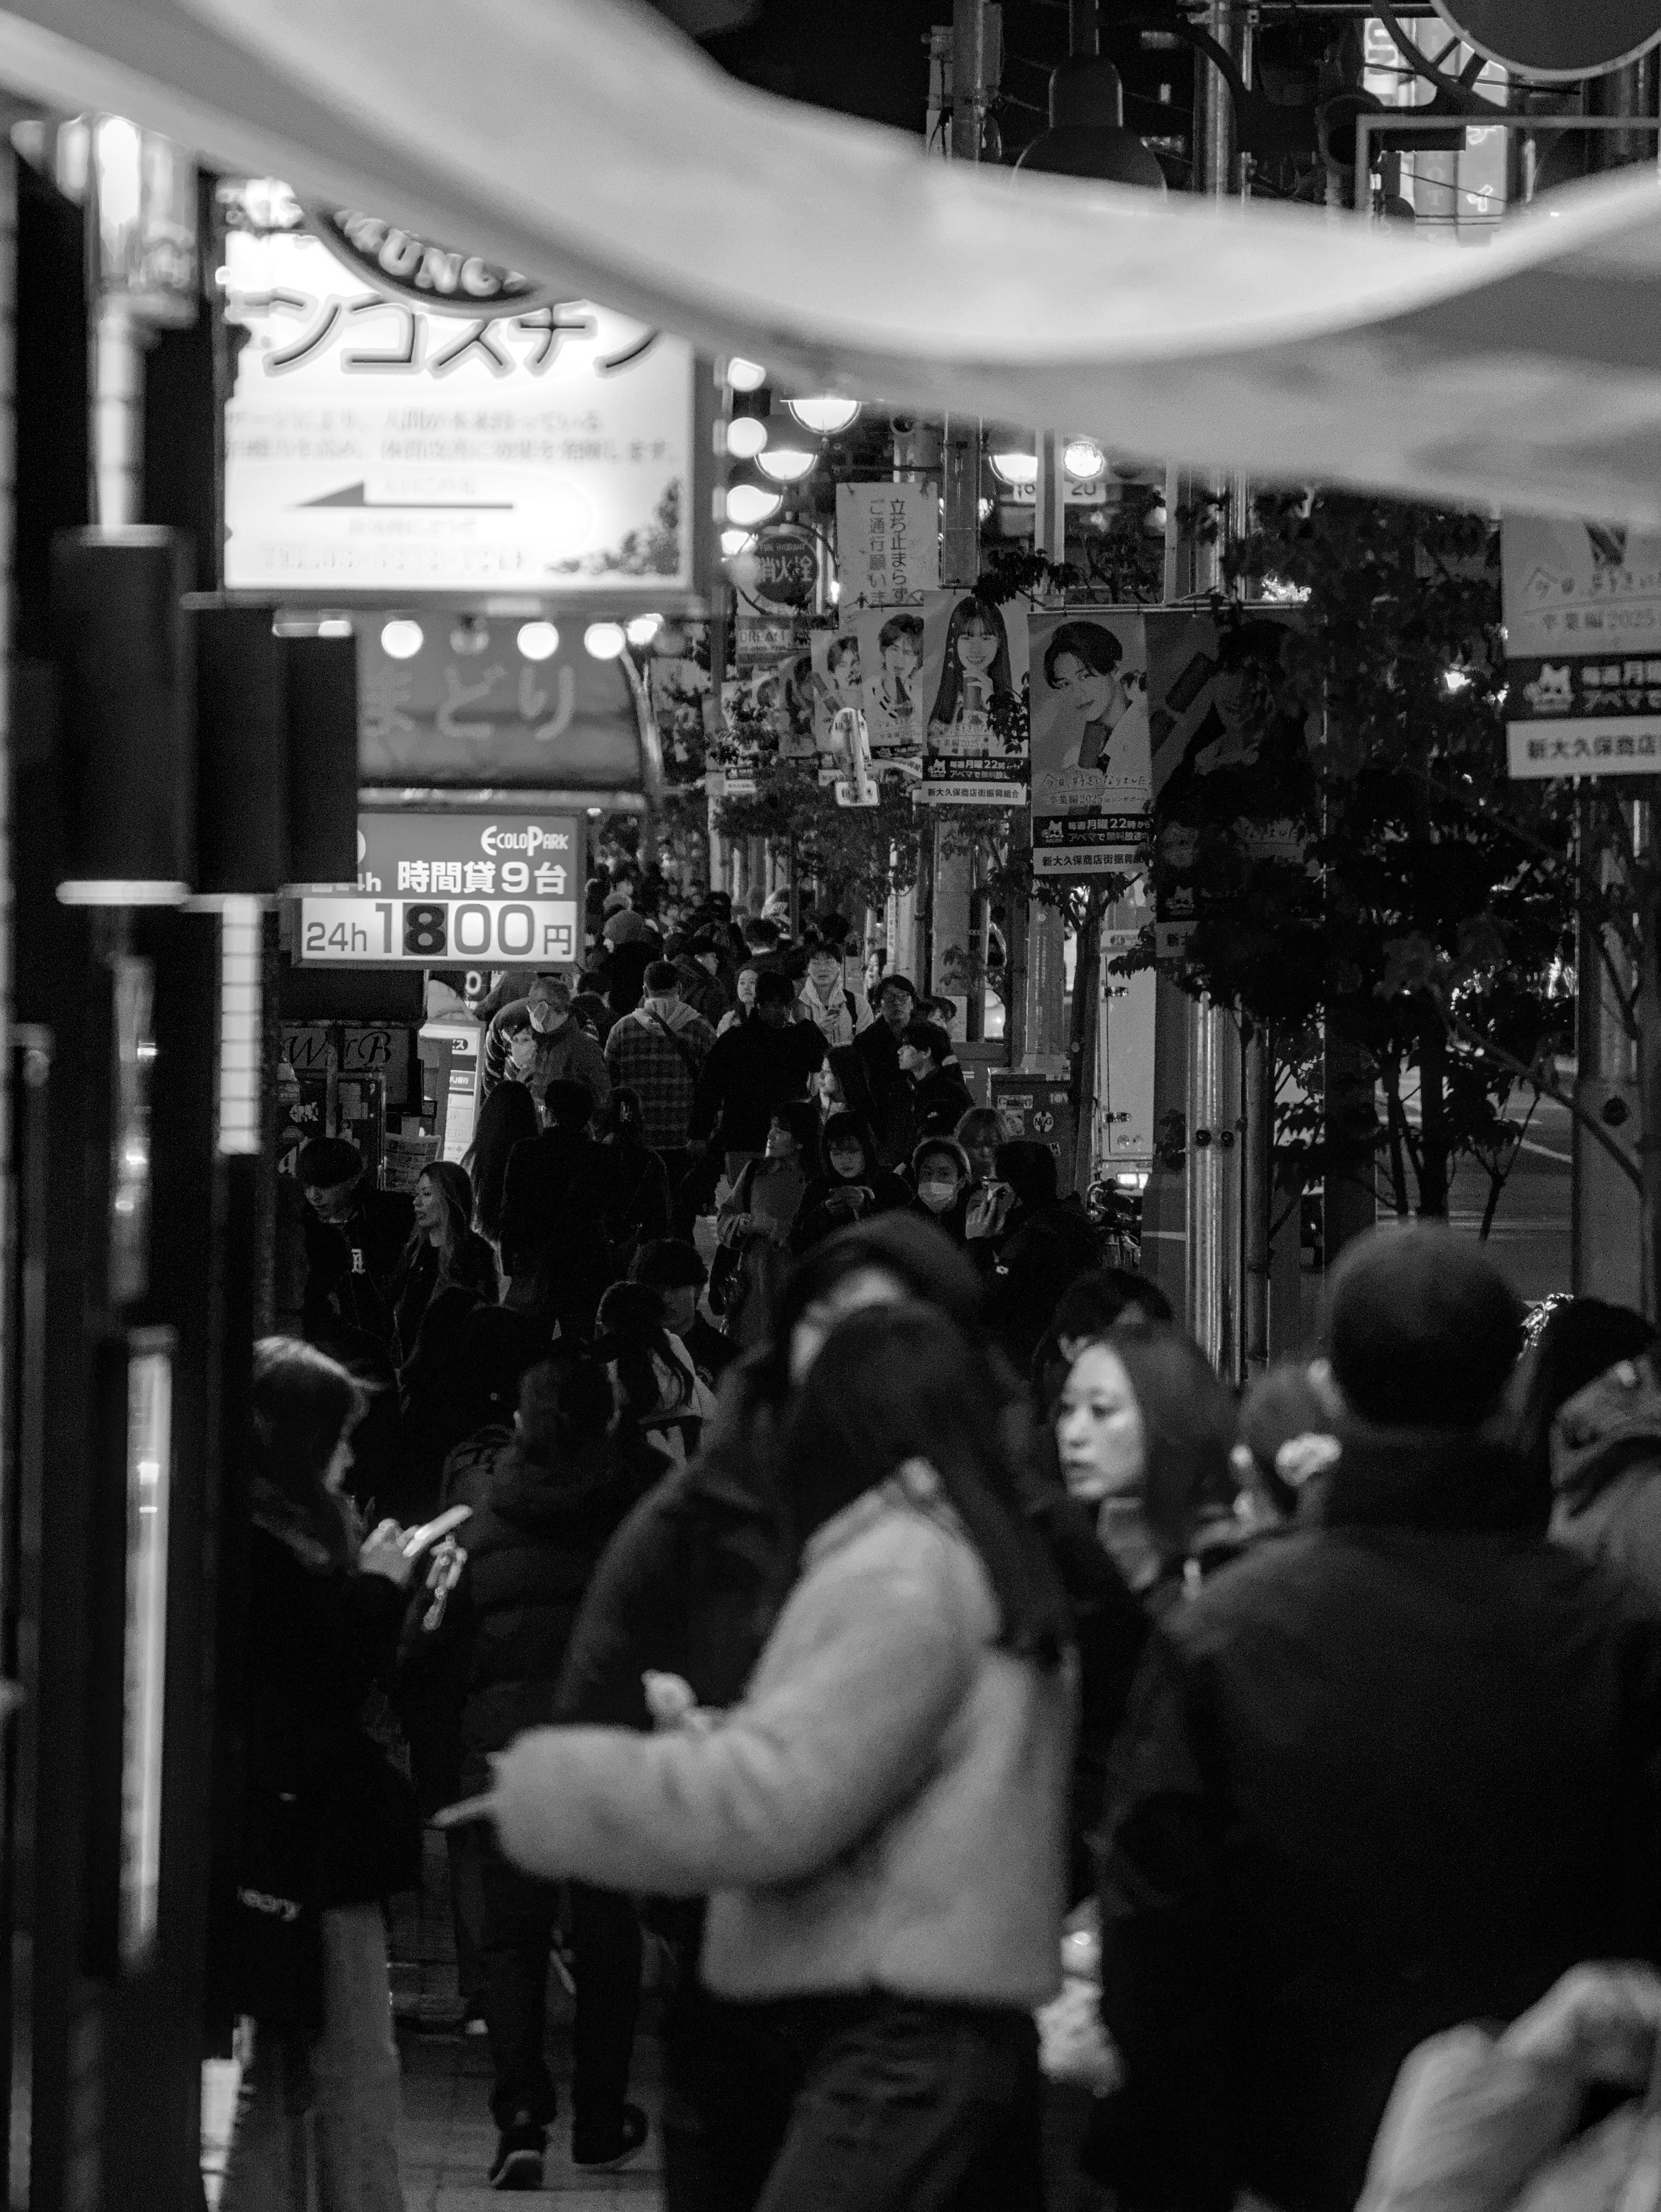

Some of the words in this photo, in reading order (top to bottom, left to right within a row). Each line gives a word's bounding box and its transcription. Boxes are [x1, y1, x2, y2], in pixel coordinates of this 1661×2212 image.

[890, 498, 908, 604] 立ち止まらず
[928, 787, 1019, 799] 新大久保商店街振興組合
[397, 860, 567, 895] 時間貸9台
[306, 921, 367, 952] 24h
[375, 901, 573, 956] 1800円
